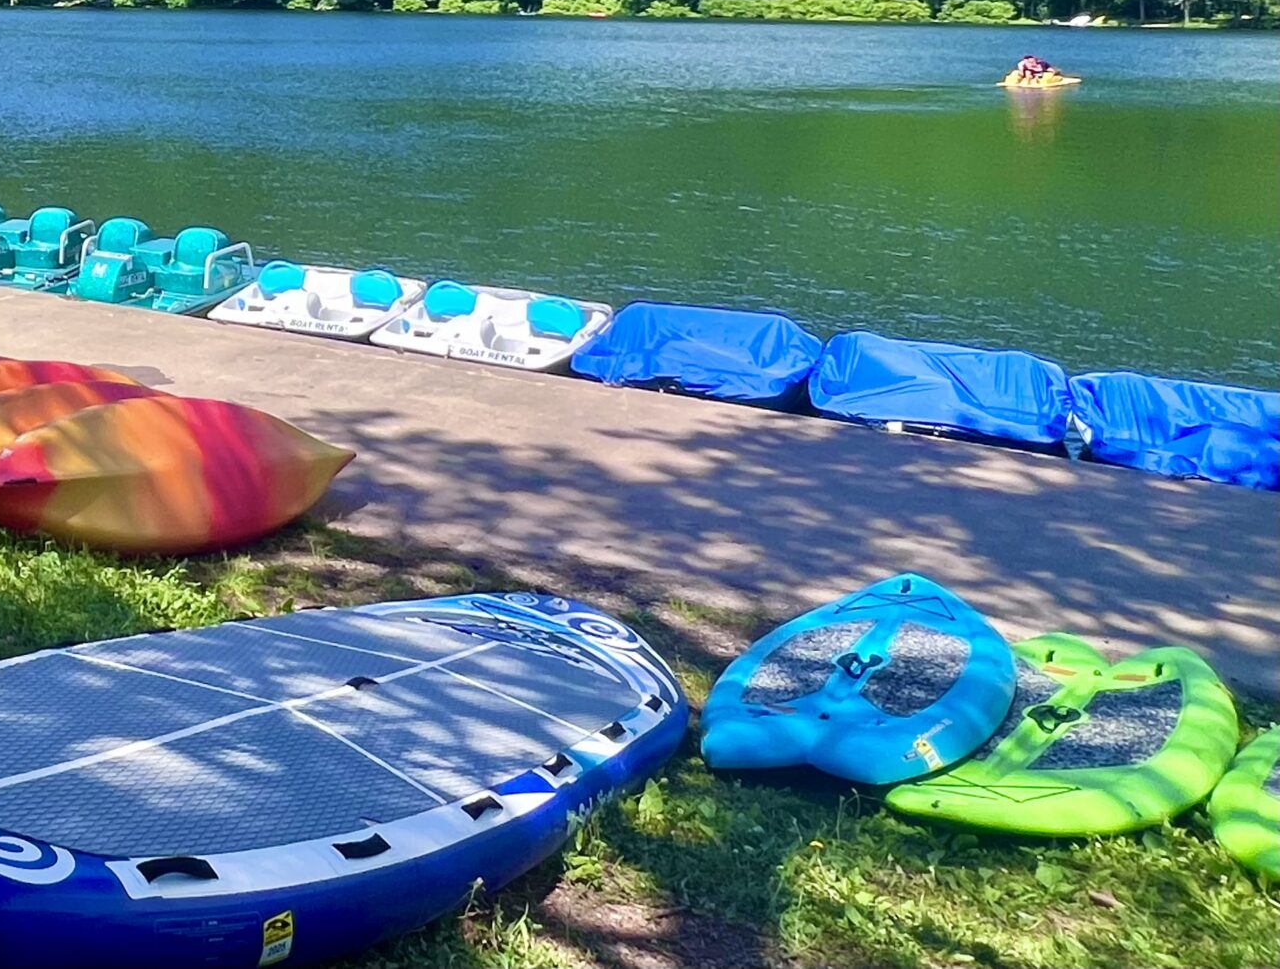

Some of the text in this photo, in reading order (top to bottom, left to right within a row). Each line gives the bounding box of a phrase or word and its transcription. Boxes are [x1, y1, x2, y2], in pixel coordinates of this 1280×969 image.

[289, 319, 312, 328] BOAT
[459, 347, 525, 365] BOAT RENTAL
